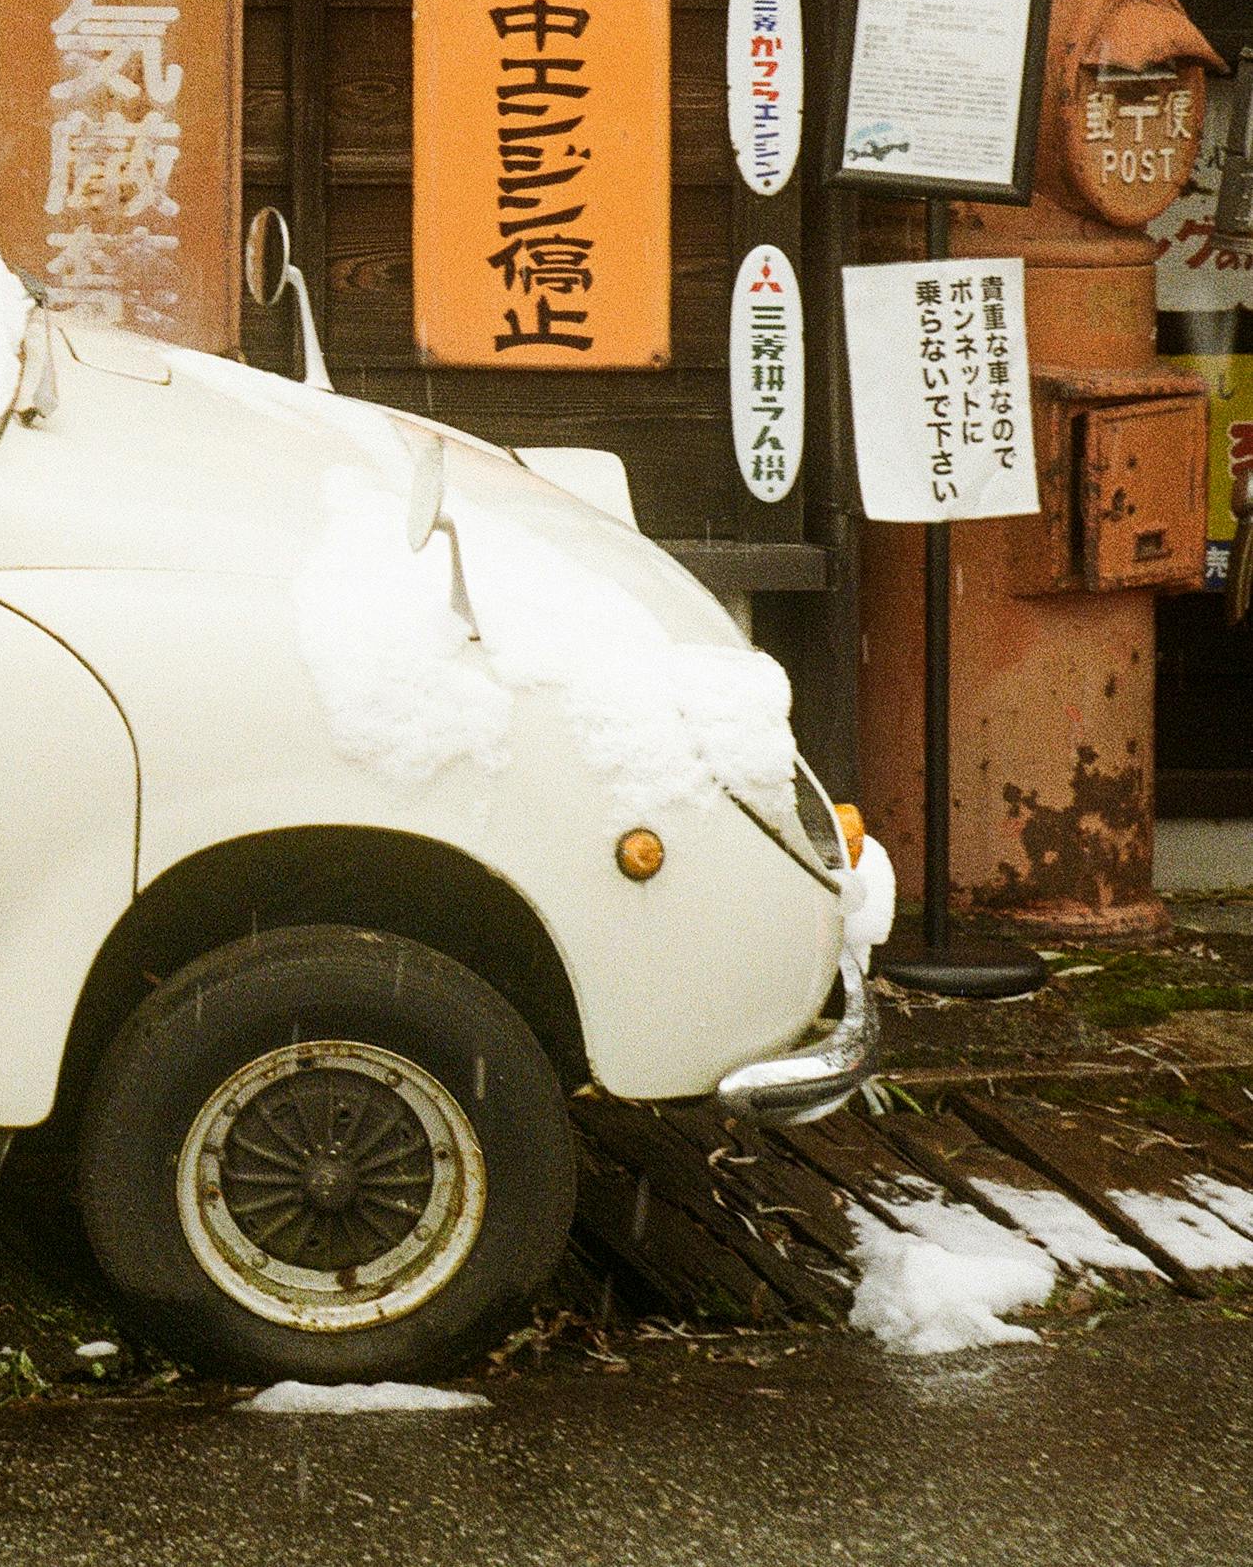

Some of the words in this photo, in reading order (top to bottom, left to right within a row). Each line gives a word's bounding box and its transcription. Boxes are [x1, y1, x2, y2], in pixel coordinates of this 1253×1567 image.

[1102, 147, 1177, 183] POST
[915, 279, 959, 503] 乗らないで下さい
[949, 276, 985, 445] ボンネットに
[980, 275, 1017, 470] 貴重な車なので
